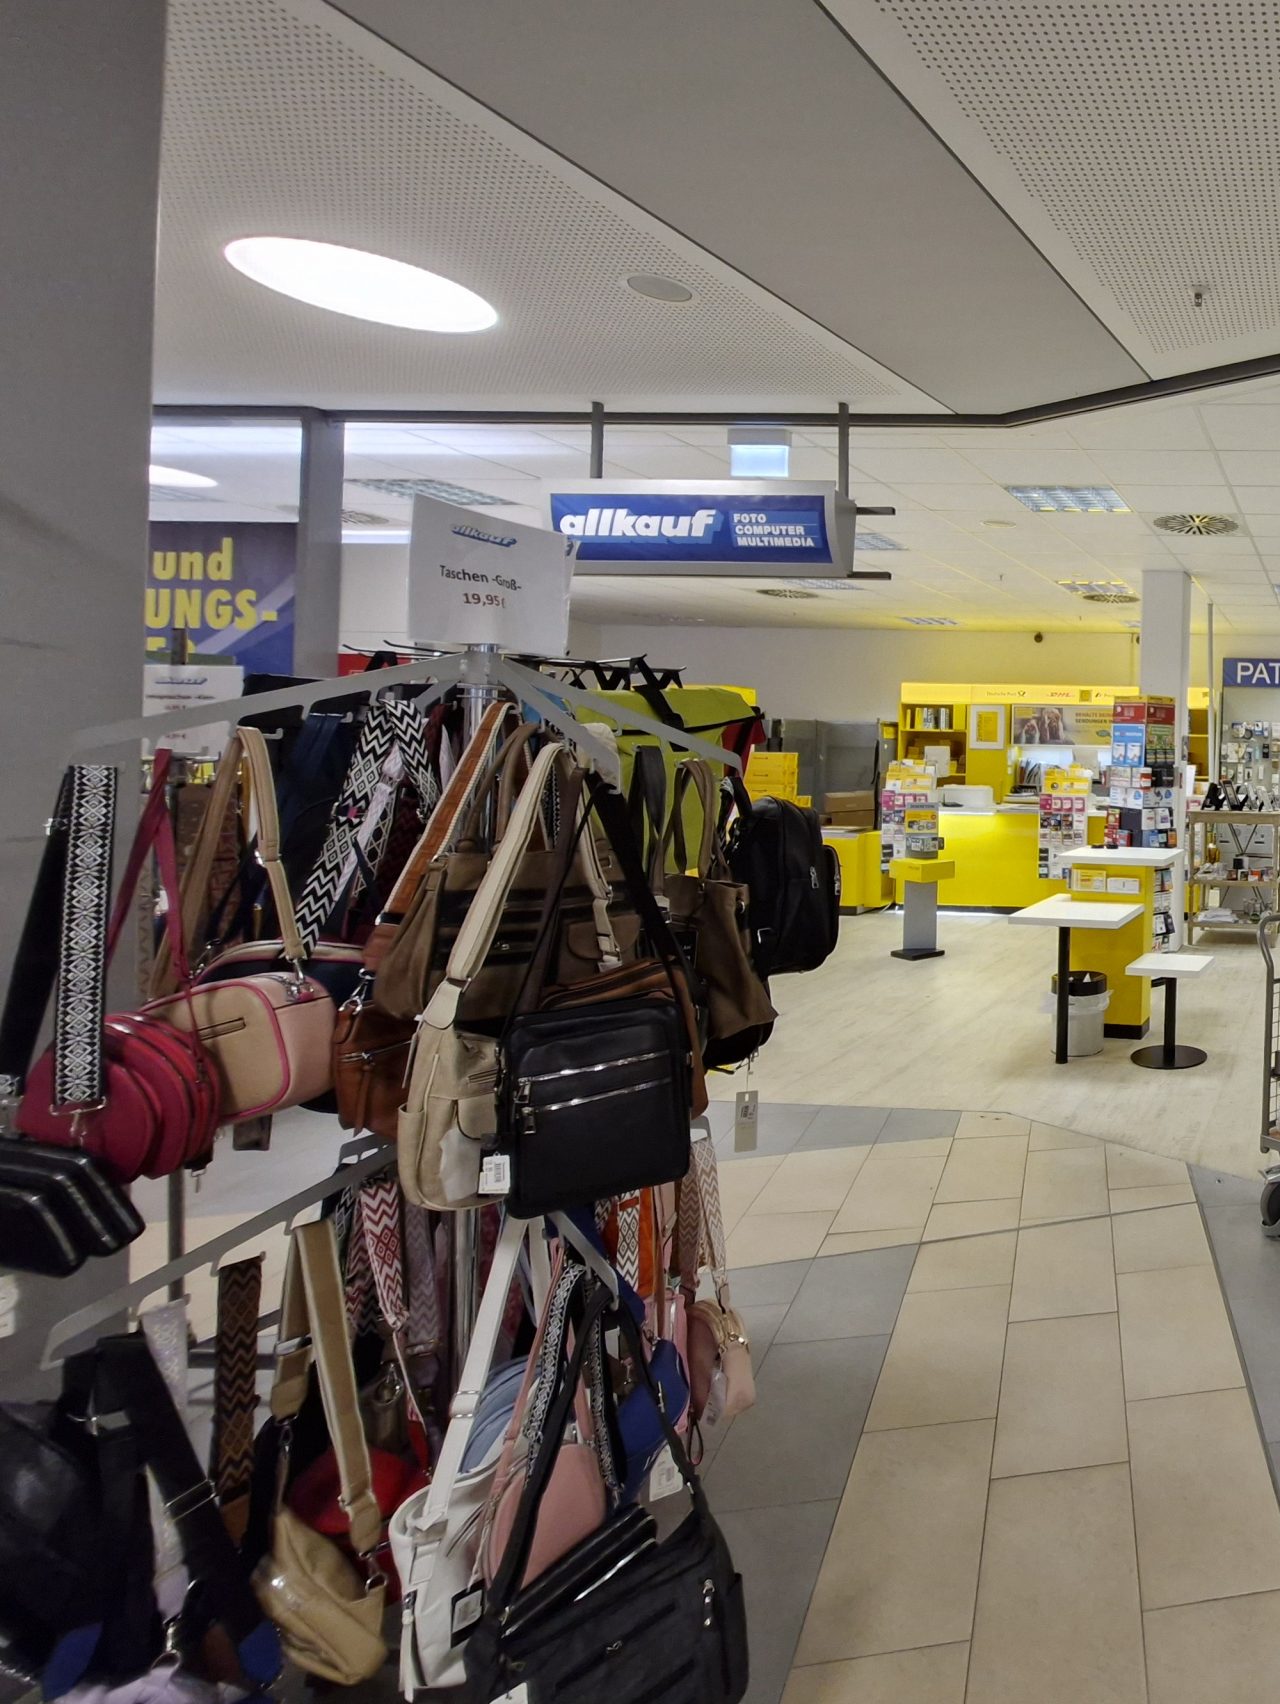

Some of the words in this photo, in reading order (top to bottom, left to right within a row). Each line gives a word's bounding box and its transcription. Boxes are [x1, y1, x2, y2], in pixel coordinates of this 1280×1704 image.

[560, 508, 717, 537] allkauf
[733, 513, 767, 525] FOTO
[735, 525, 805, 536] COMPUTER
[737, 536, 815, 547] MULTIMEDIA
[153, 537, 234, 581] und
[440, 565, 489, 584] Taschen
